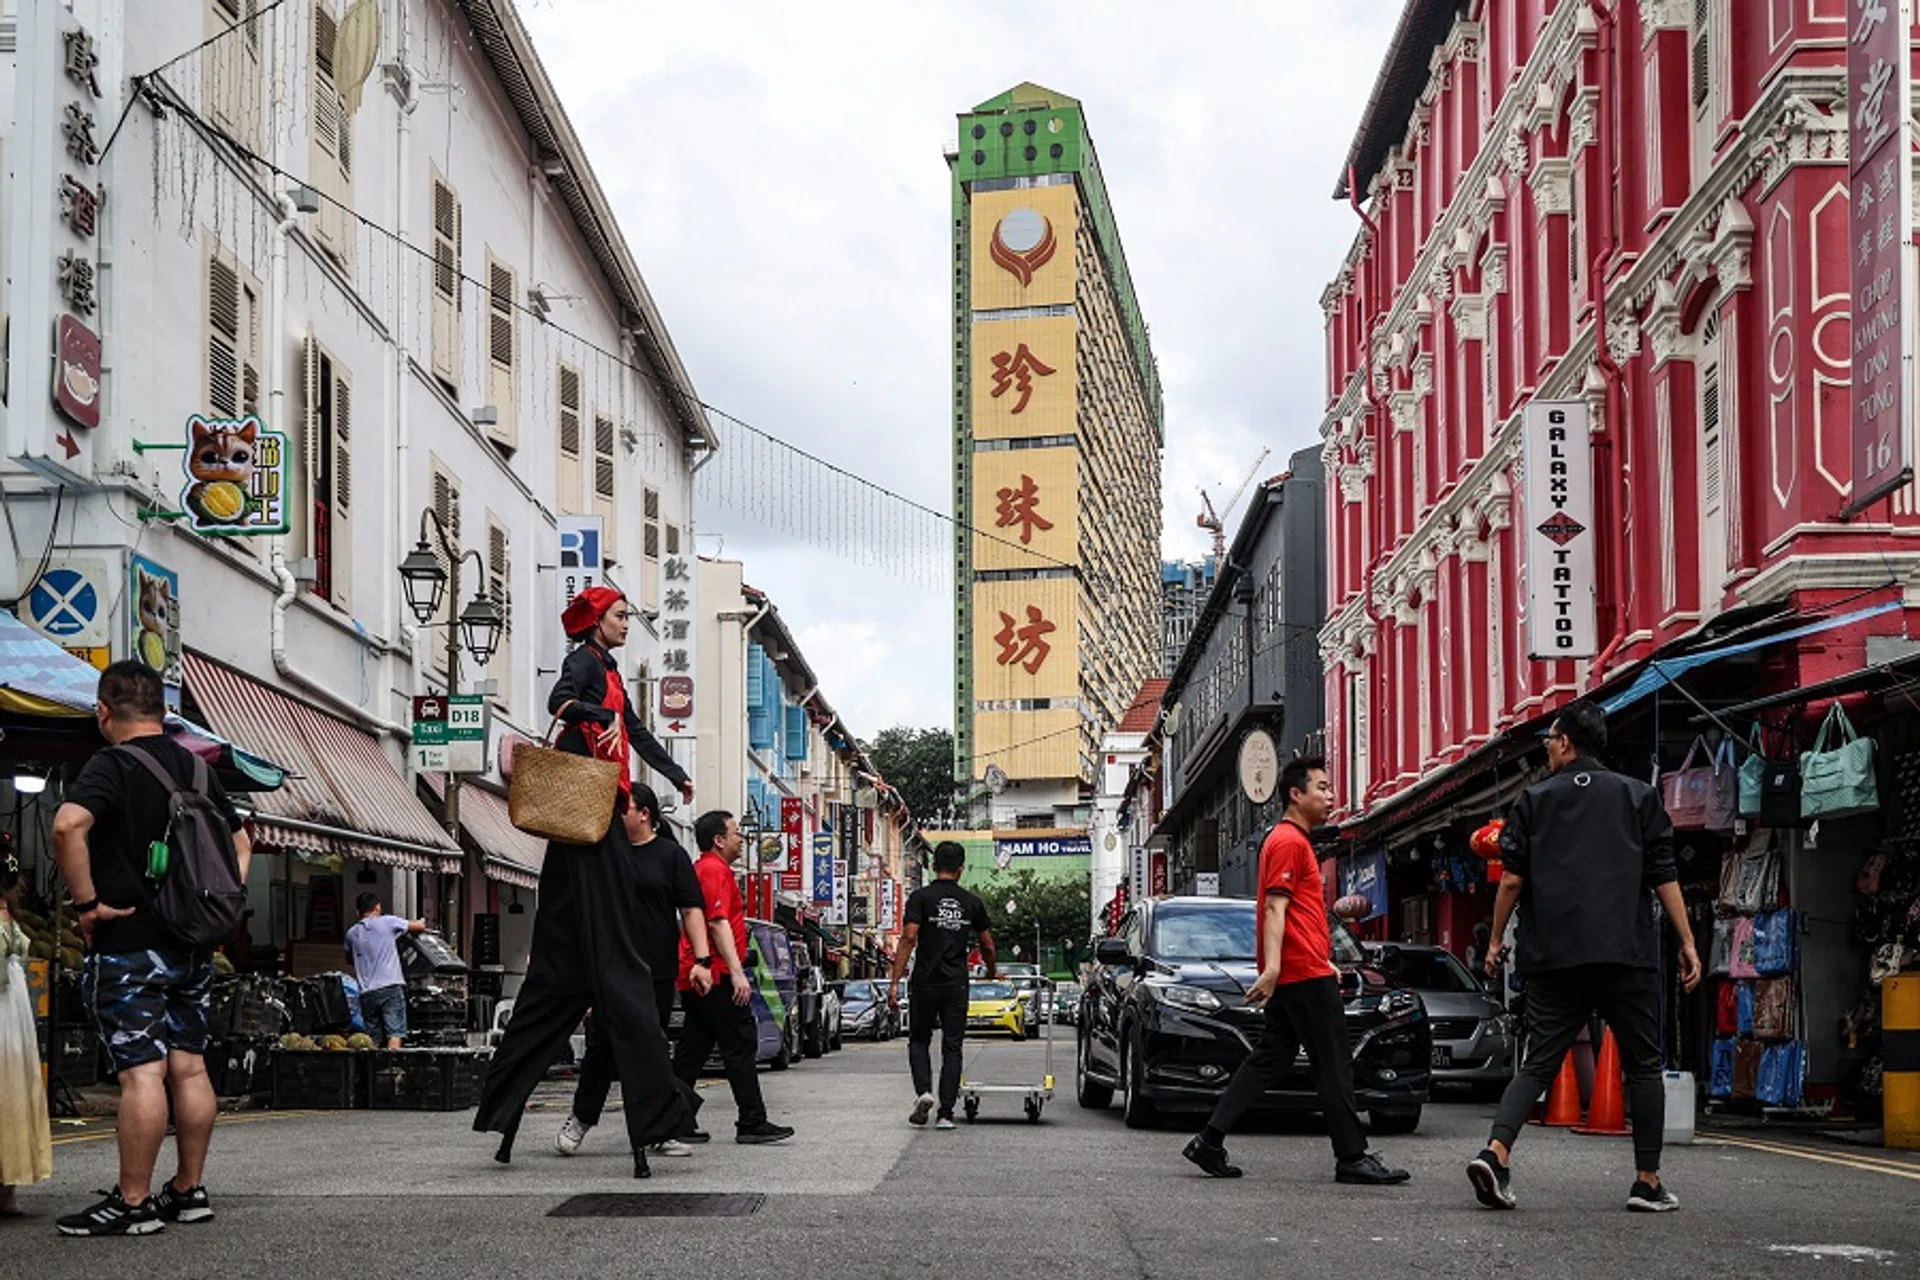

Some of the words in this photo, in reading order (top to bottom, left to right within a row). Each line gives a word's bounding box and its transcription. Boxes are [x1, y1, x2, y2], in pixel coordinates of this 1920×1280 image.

[1860, 268, 1893, 314] CHOP
[1854, 298, 1900, 352] KWONG
[1864, 346, 1889, 384] ONN
[1860, 382, 1895, 425] TONG
[1548, 410, 1567, 509] GALAXY
[1863, 430, 1892, 481] 16
[990, 343, 1057, 675] 珍珠坊
[663, 556, 691, 672] 飲茶酒樓
[1553, 550, 1573, 648] TATTOO
[420, 724, 442, 734] Taxi
[452, 711, 479, 722] D18
[418, 749, 427, 767] 1
[1038, 842, 1059, 853] HO
